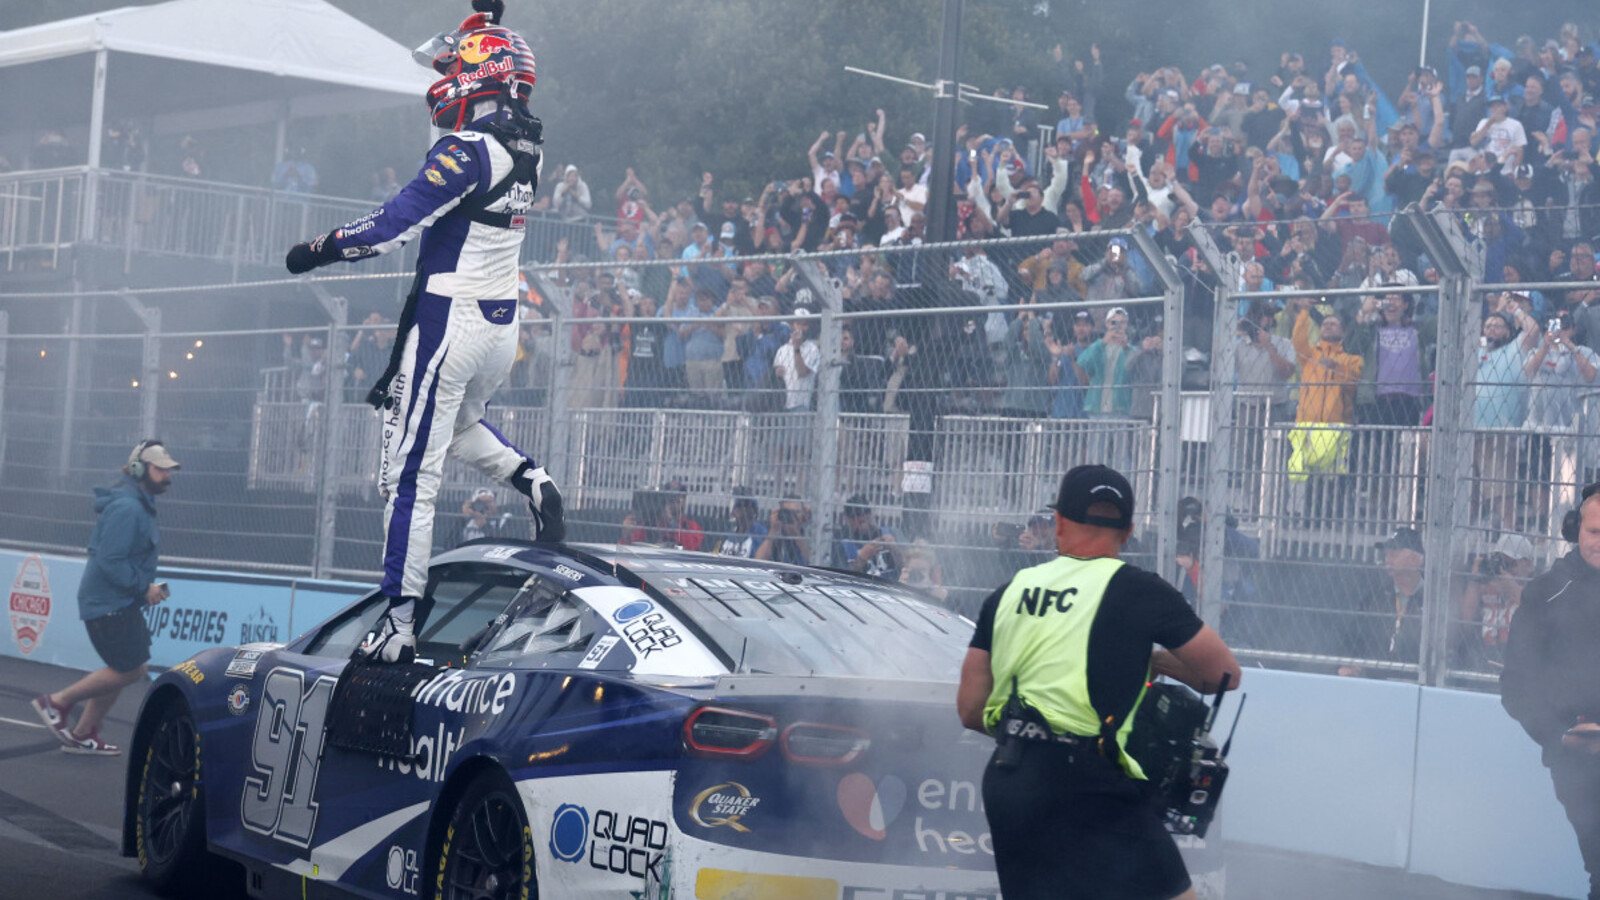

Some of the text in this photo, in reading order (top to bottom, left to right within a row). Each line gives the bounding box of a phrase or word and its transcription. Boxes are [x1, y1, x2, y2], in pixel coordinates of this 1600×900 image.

[457, 56, 515, 87] Red Bull
[344, 220, 376, 238] health
[385, 373, 406, 427] health
[1016, 586, 1078, 617] NFC
[170, 607, 228, 644] SERIES
[240, 622, 278, 645] BUSCH
[622, 620, 663, 660] LOCK
[643, 613, 682, 648] QUAD
[241, 666, 338, 849] 91
[708, 793, 760, 808] QUAKER
[711, 804, 750, 816] STATE
[593, 809, 668, 851] QUAD
[589, 840, 664, 884] LOCK
